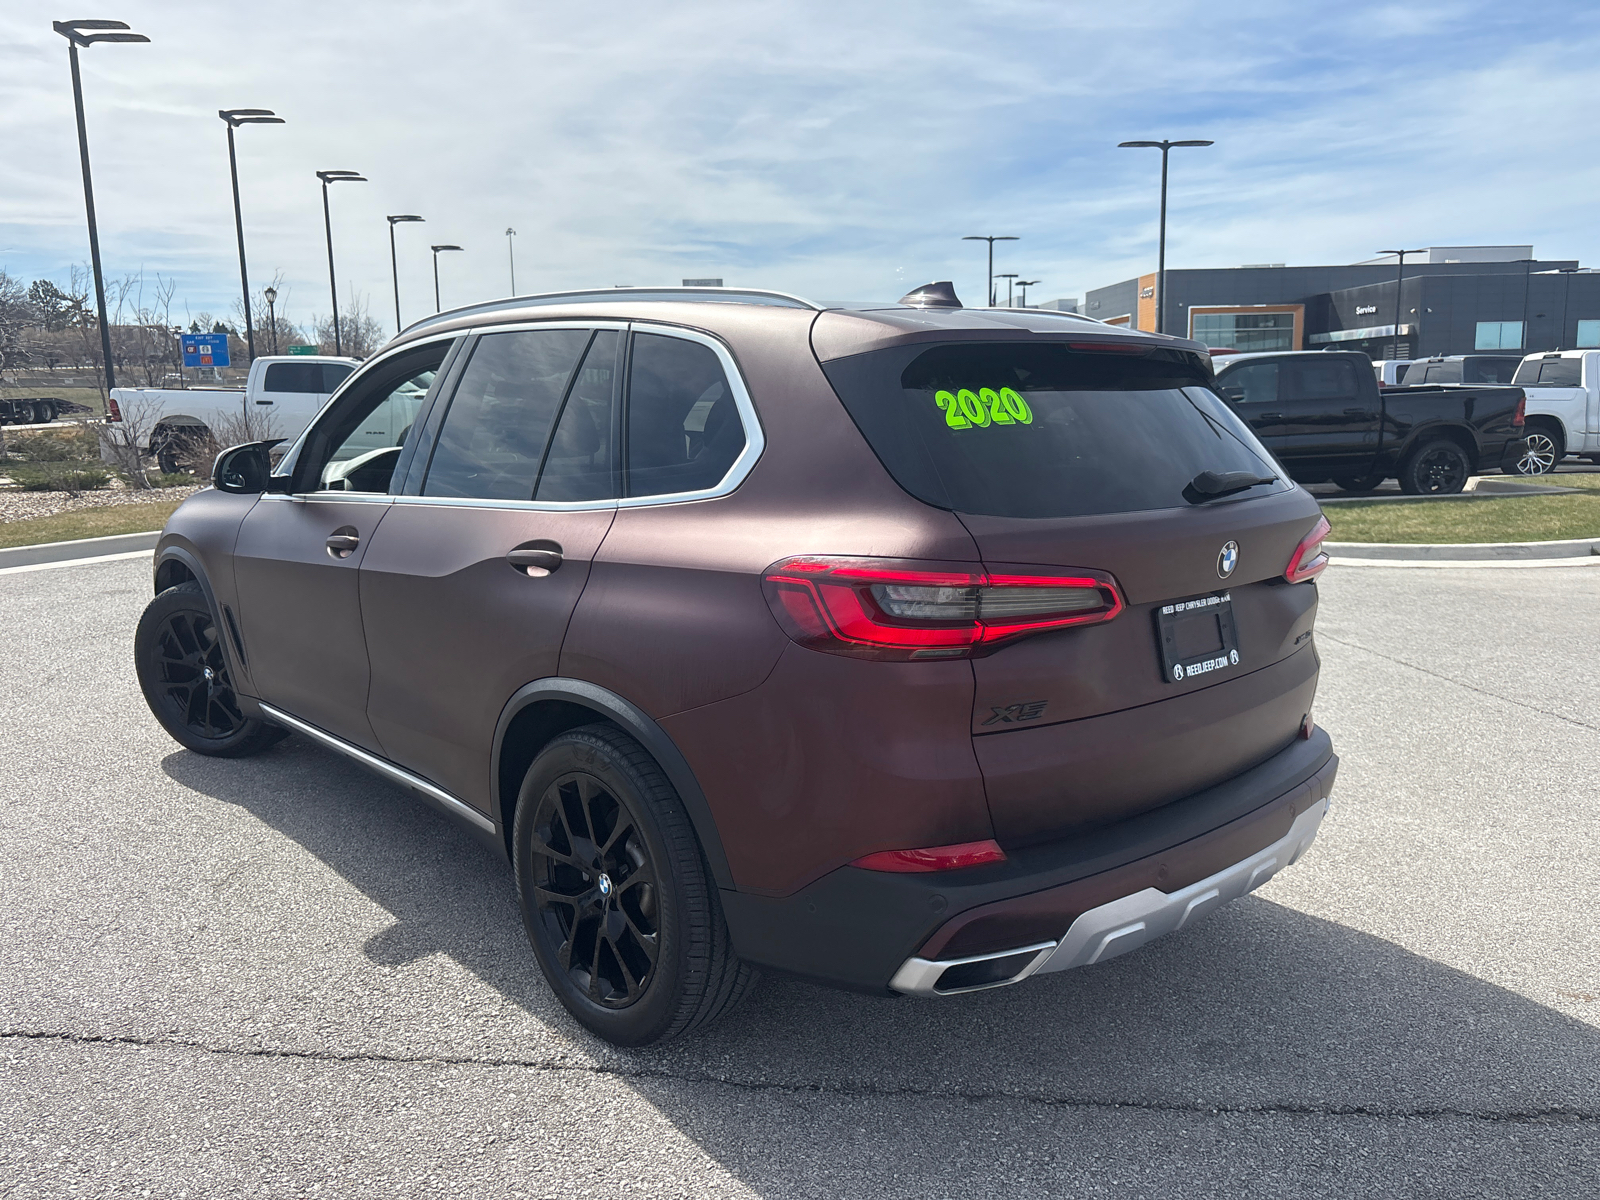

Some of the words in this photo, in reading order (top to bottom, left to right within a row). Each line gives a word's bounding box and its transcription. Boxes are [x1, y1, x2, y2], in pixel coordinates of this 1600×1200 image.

[1356, 305, 1377, 315] Service
[935, 387, 1033, 430] 2020
[1162, 605, 1174, 615] REED
[1185, 598, 1207, 610] CHRYSLER
[1186, 656, 1229, 677] REEDJEEP.COM
[981, 700, 1049, 726] X5
